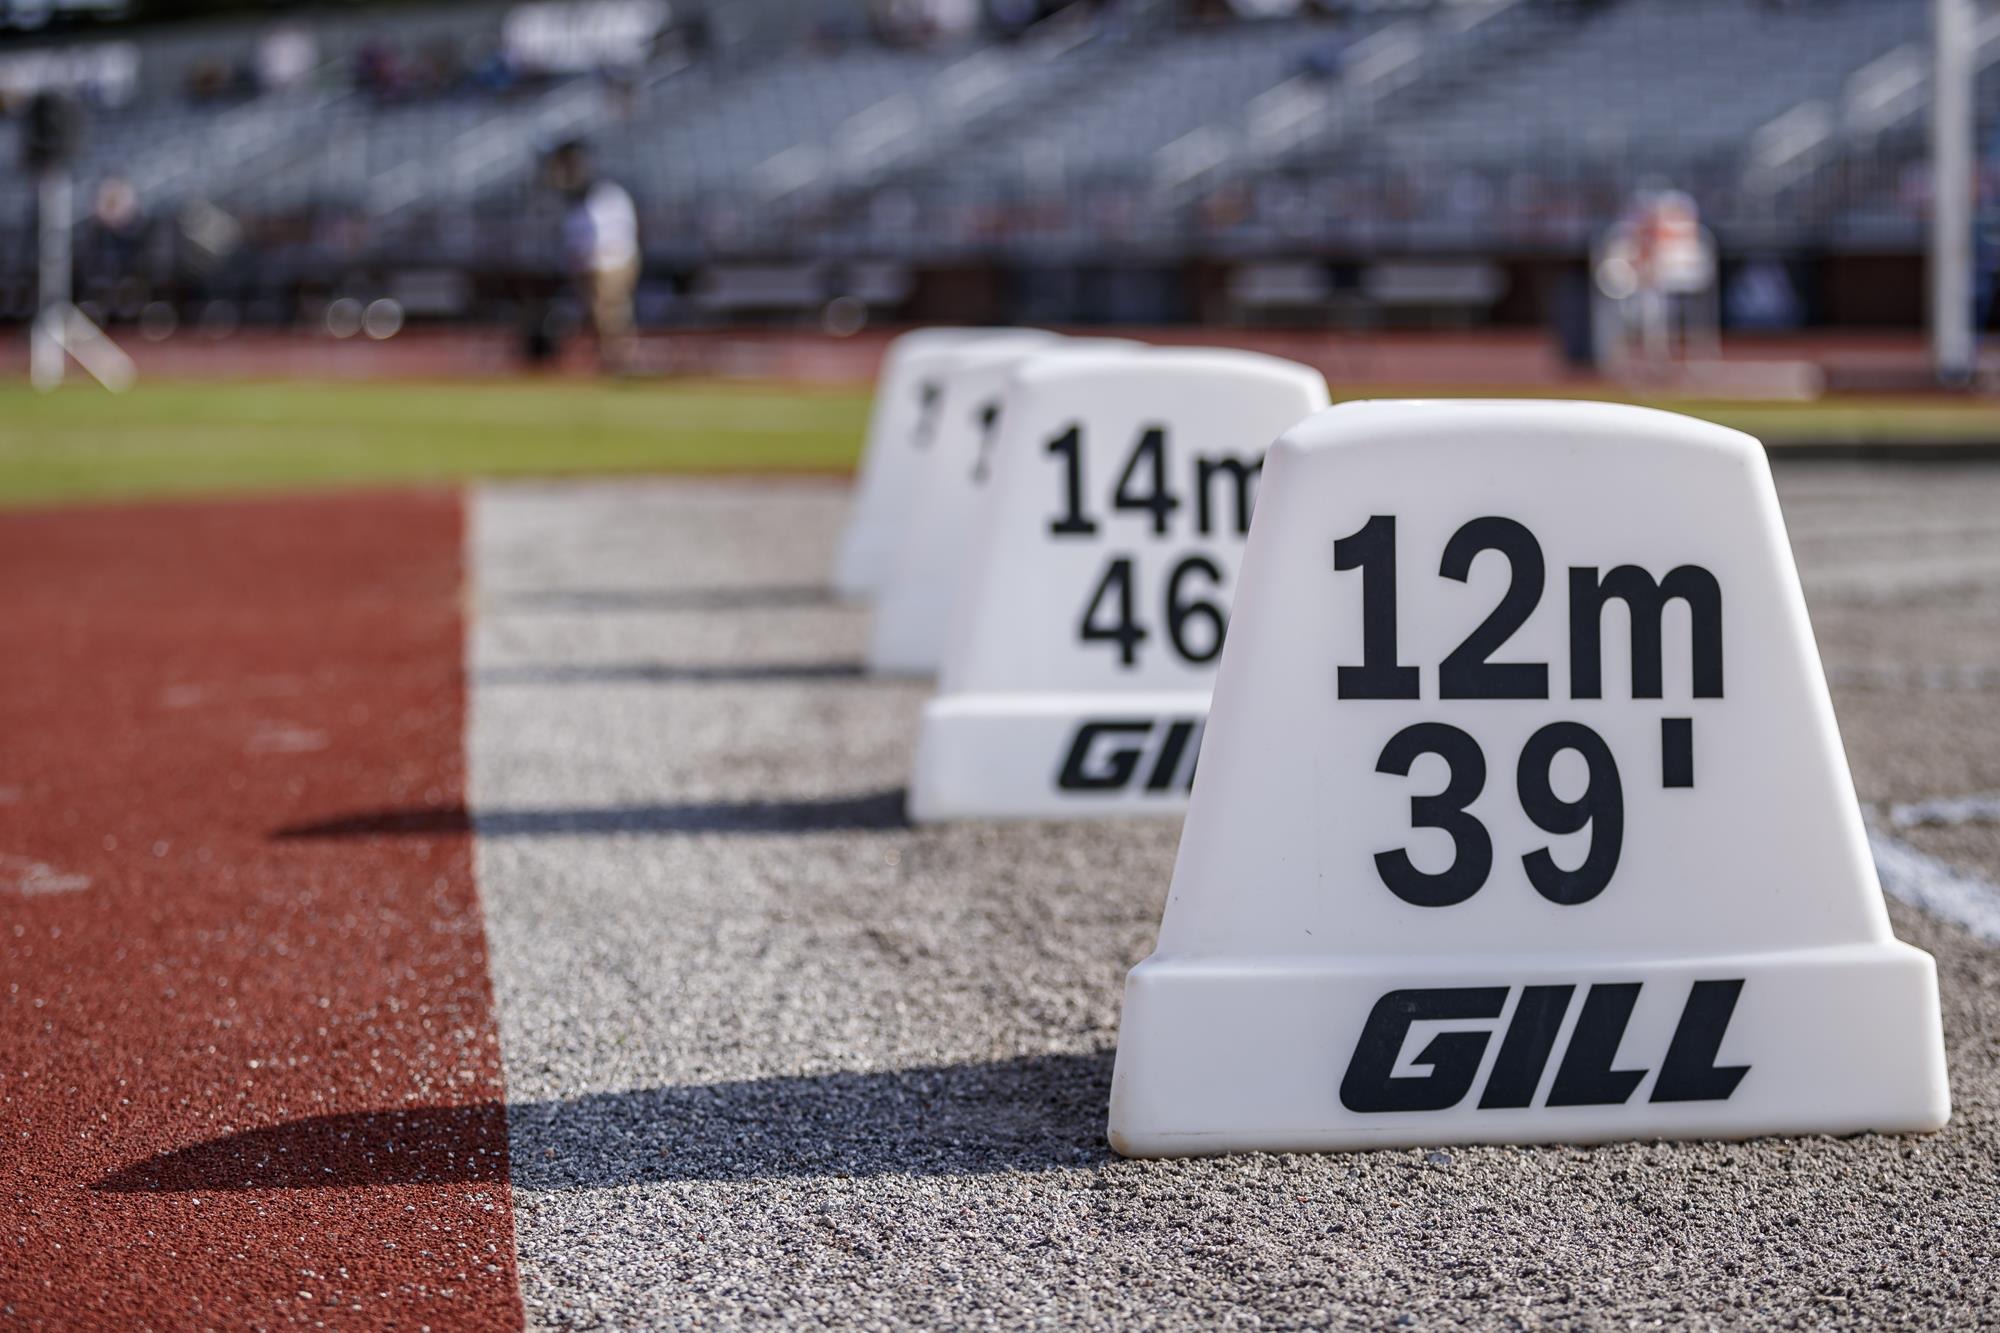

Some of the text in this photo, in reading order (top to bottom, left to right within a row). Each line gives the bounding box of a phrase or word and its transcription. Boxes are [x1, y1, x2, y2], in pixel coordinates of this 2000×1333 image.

[1045, 423, 1266, 537] 14m
[1333, 514, 1725, 701] 12m
[1056, 719, 1203, 795] GI
[1373, 717, 1695, 908] 39'
[1338, 978, 1752, 1113] GILL
